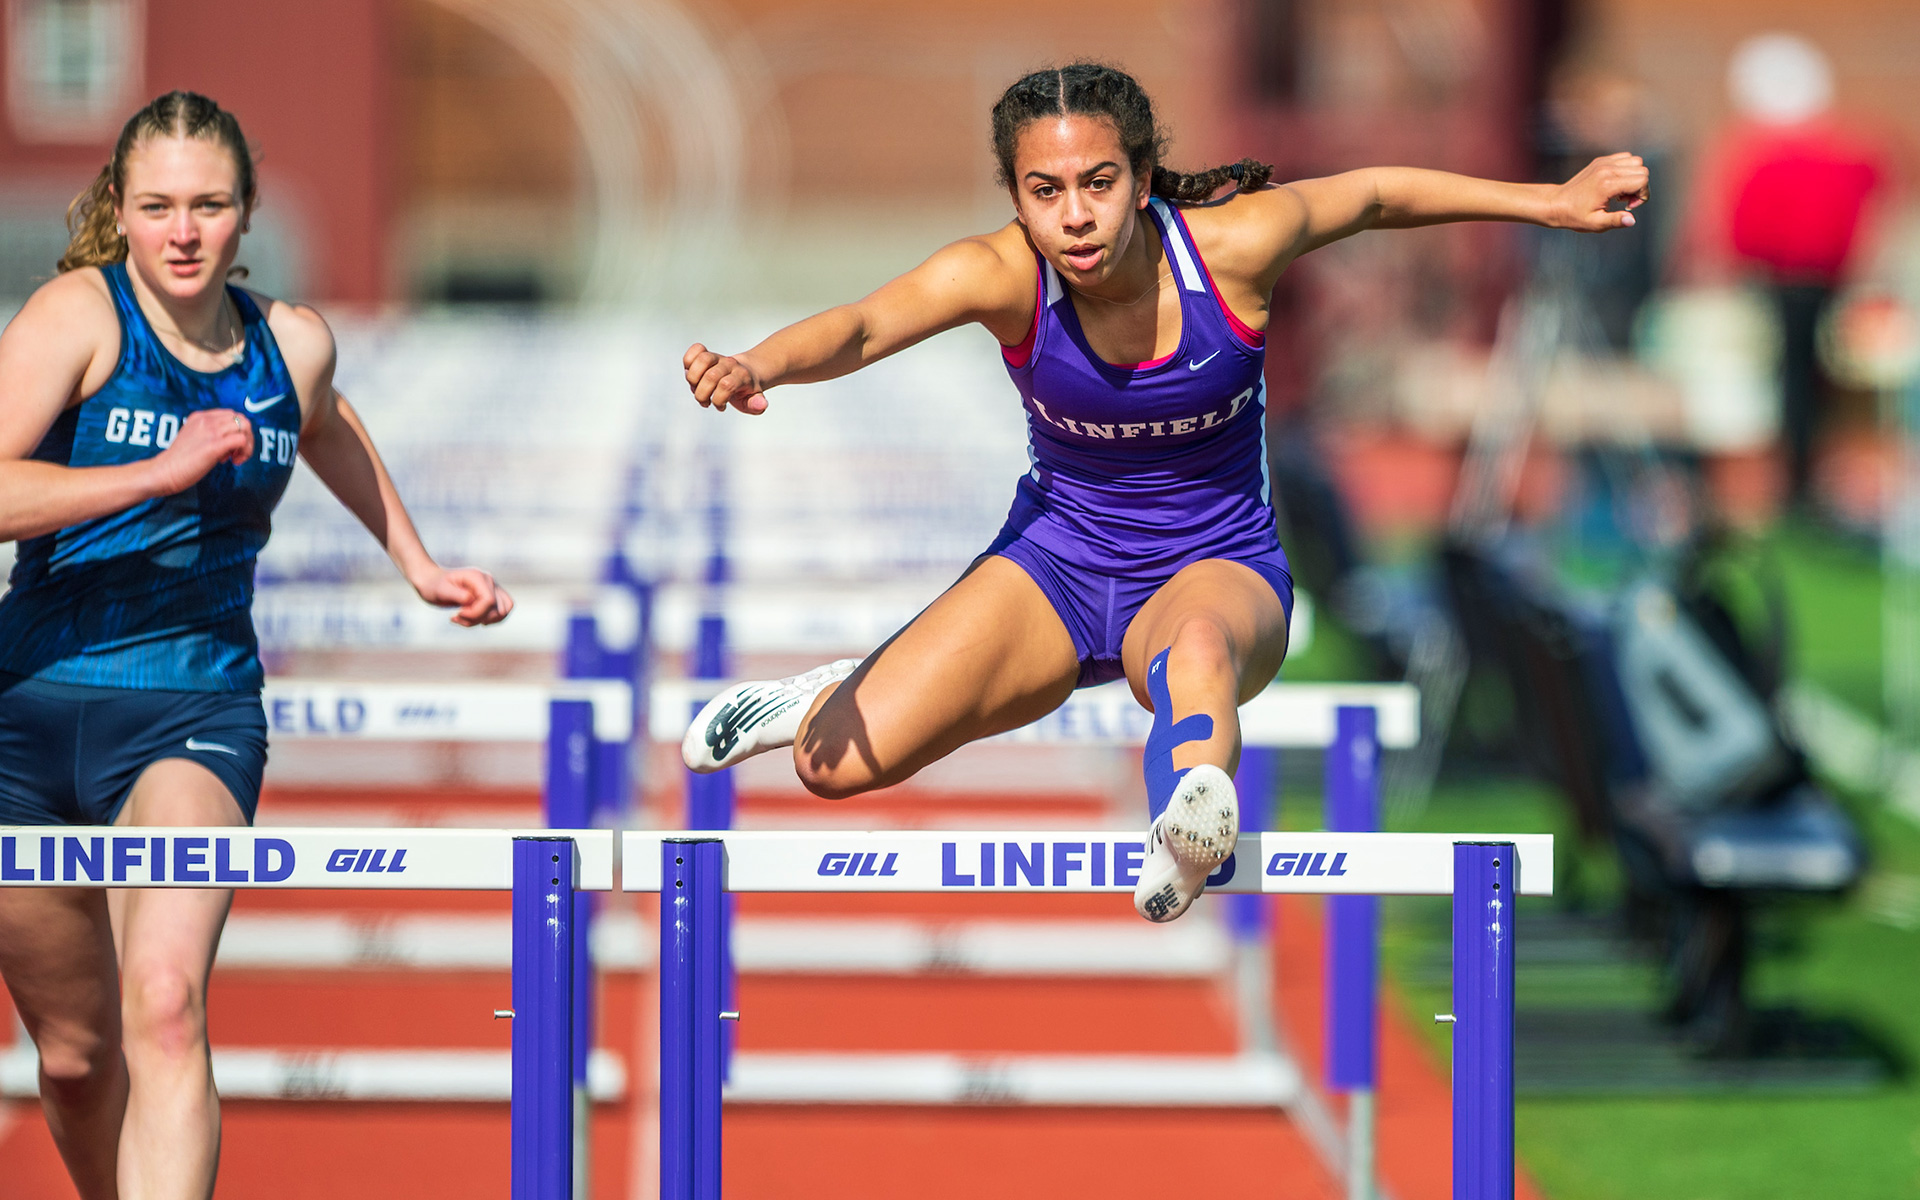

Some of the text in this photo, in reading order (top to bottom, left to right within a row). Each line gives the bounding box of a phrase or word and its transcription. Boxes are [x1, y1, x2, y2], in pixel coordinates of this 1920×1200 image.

[104, 407, 187, 449] GEO
[1032, 387, 1254, 440] LINFIELD
[760, 707, 787, 728] balance
[2, 836, 407, 883] LINFIELD GILL
[817, 842, 1348, 888] GILL LINFIE GILL
